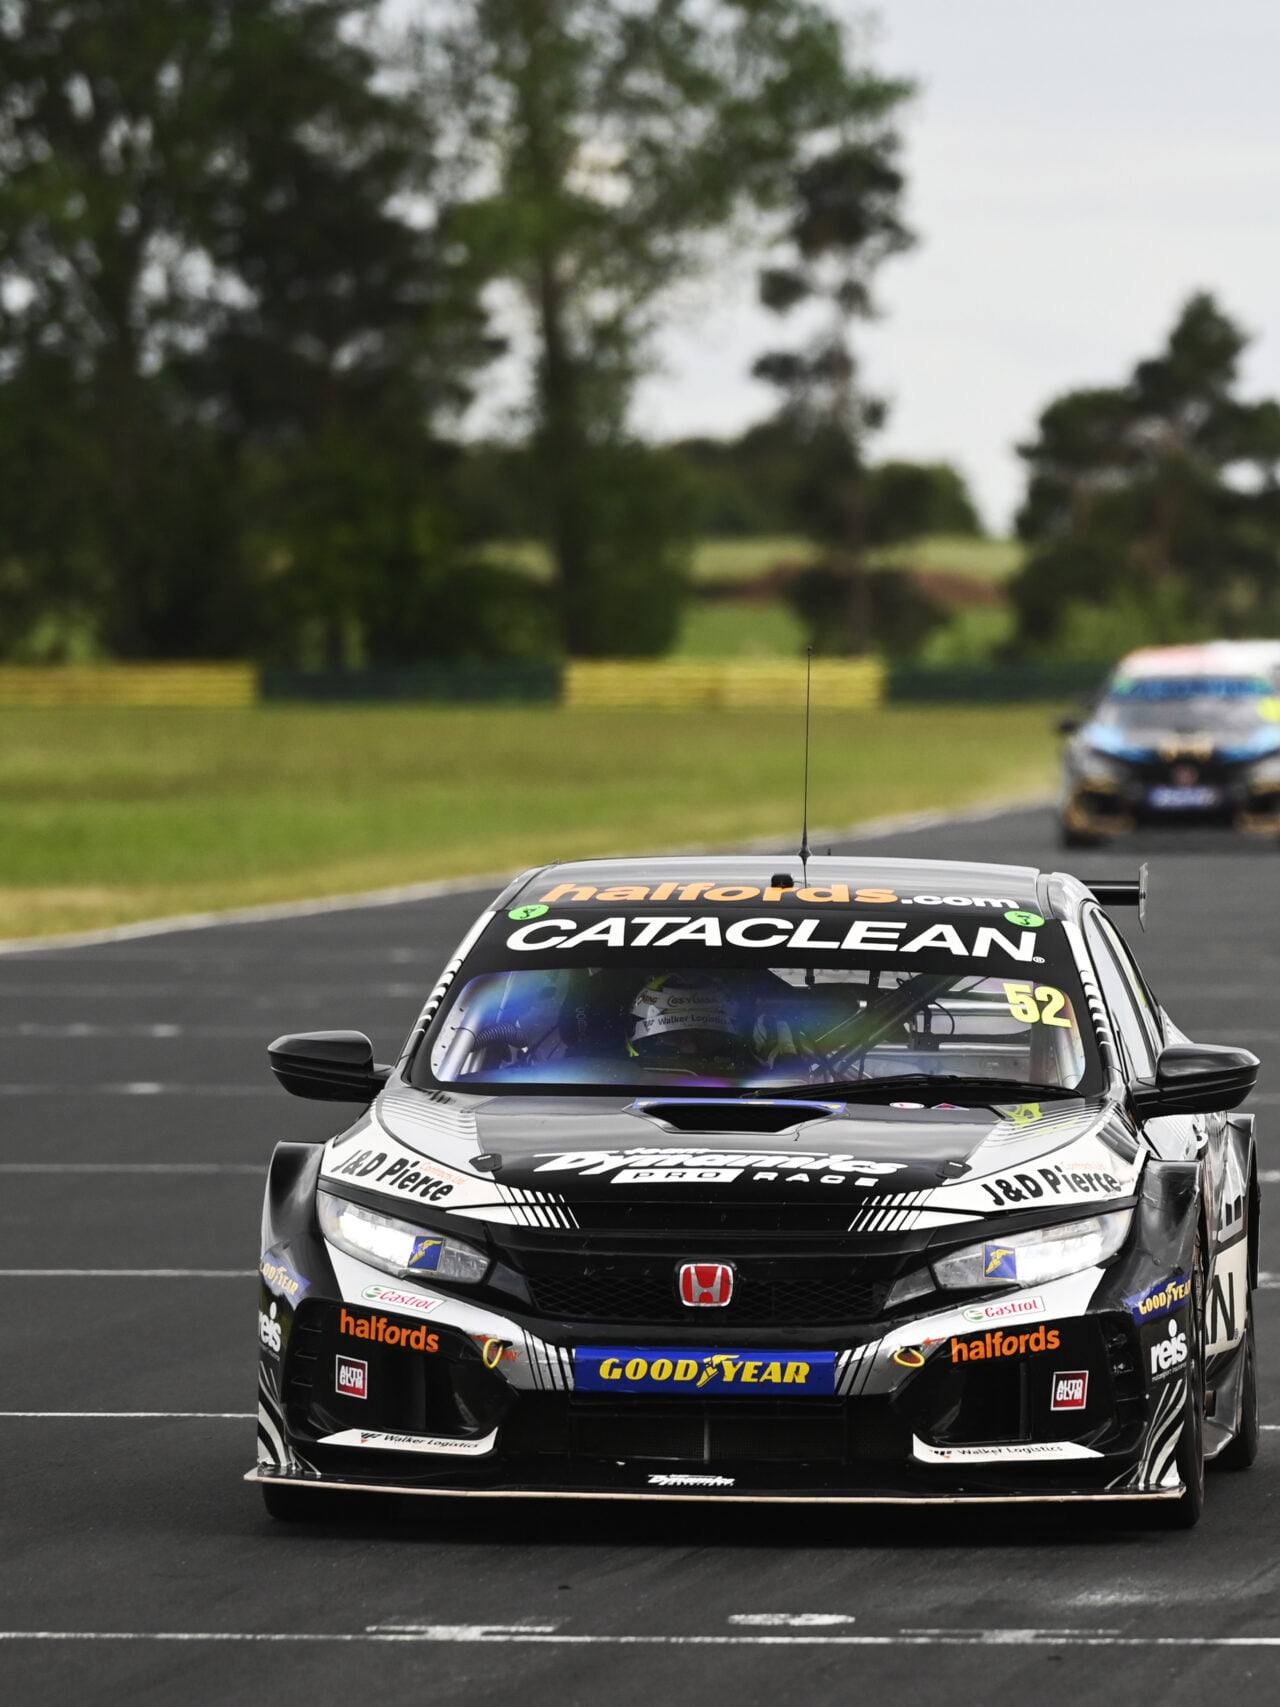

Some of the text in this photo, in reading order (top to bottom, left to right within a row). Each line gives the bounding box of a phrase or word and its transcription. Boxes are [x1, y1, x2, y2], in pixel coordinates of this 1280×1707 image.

[539, 882, 1020, 909] halfords.com
[506, 916, 1037, 962] CATACLEAN
[1003, 983, 1072, 1028] 52
[331, 1150, 453, 1201] J&D Pierce
[533, 1151, 909, 1176] Dynamics
[632, 1171, 878, 1187] PRO RACE
[981, 1165, 1121, 1206] J&D Pierce
[380, 1290, 436, 1310] Castrol
[984, 1299, 1038, 1318] Castrol
[1138, 1280, 1191, 1315] GOODYEA
[340, 1308, 439, 1353] halfords
[951, 1325, 1061, 1363] halfords
[1151, 1318, 1188, 1375] reis
[339, 1374, 363, 1389] GLYM
[340, 1365, 363, 1380] AUTO
[599, 1356, 810, 1384] GOODYEAR
[1056, 1388, 1083, 1401] GLYM
[1057, 1379, 1083, 1391] AUTO
[384, 1434, 479, 1448] Walker Logistics
